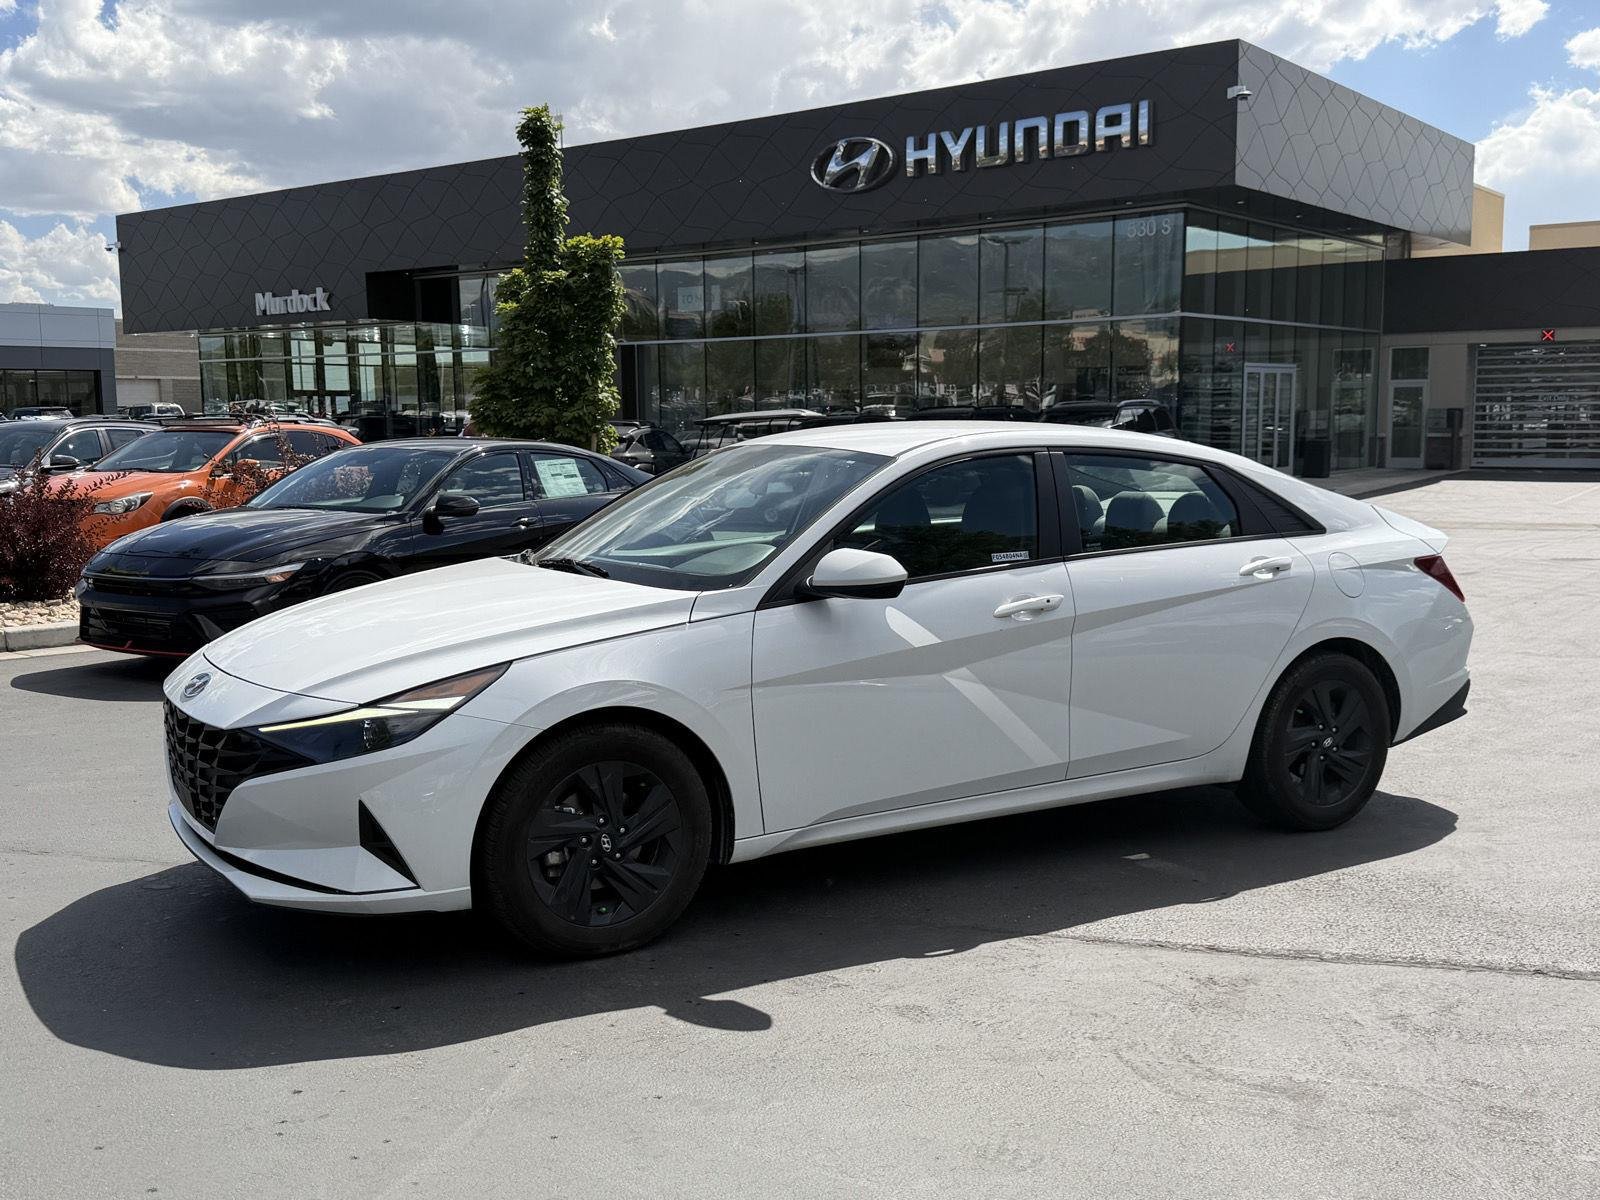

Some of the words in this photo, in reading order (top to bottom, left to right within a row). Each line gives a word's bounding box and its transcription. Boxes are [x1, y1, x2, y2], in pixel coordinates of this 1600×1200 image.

[905, 99, 1152, 178] HYUNDAI
[1161, 218, 1171, 235] S
[255, 287, 331, 316] Murdock
